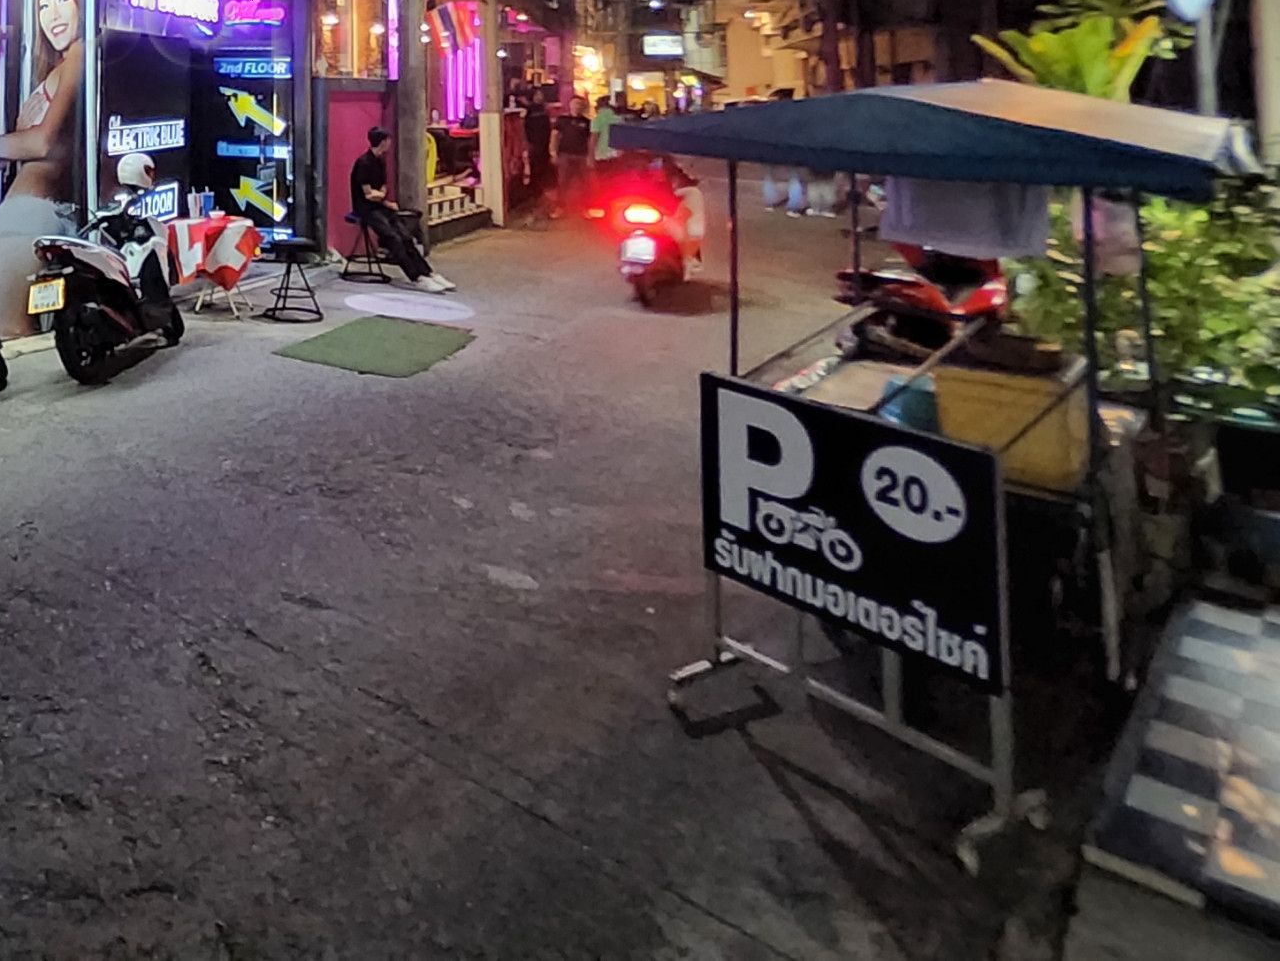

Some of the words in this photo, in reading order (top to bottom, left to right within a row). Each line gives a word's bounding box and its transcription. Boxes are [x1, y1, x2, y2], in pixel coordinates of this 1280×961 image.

[219, 63, 242, 74] 2nd
[243, 62, 288, 74] FLOOR
[717, 387, 815, 531] P
